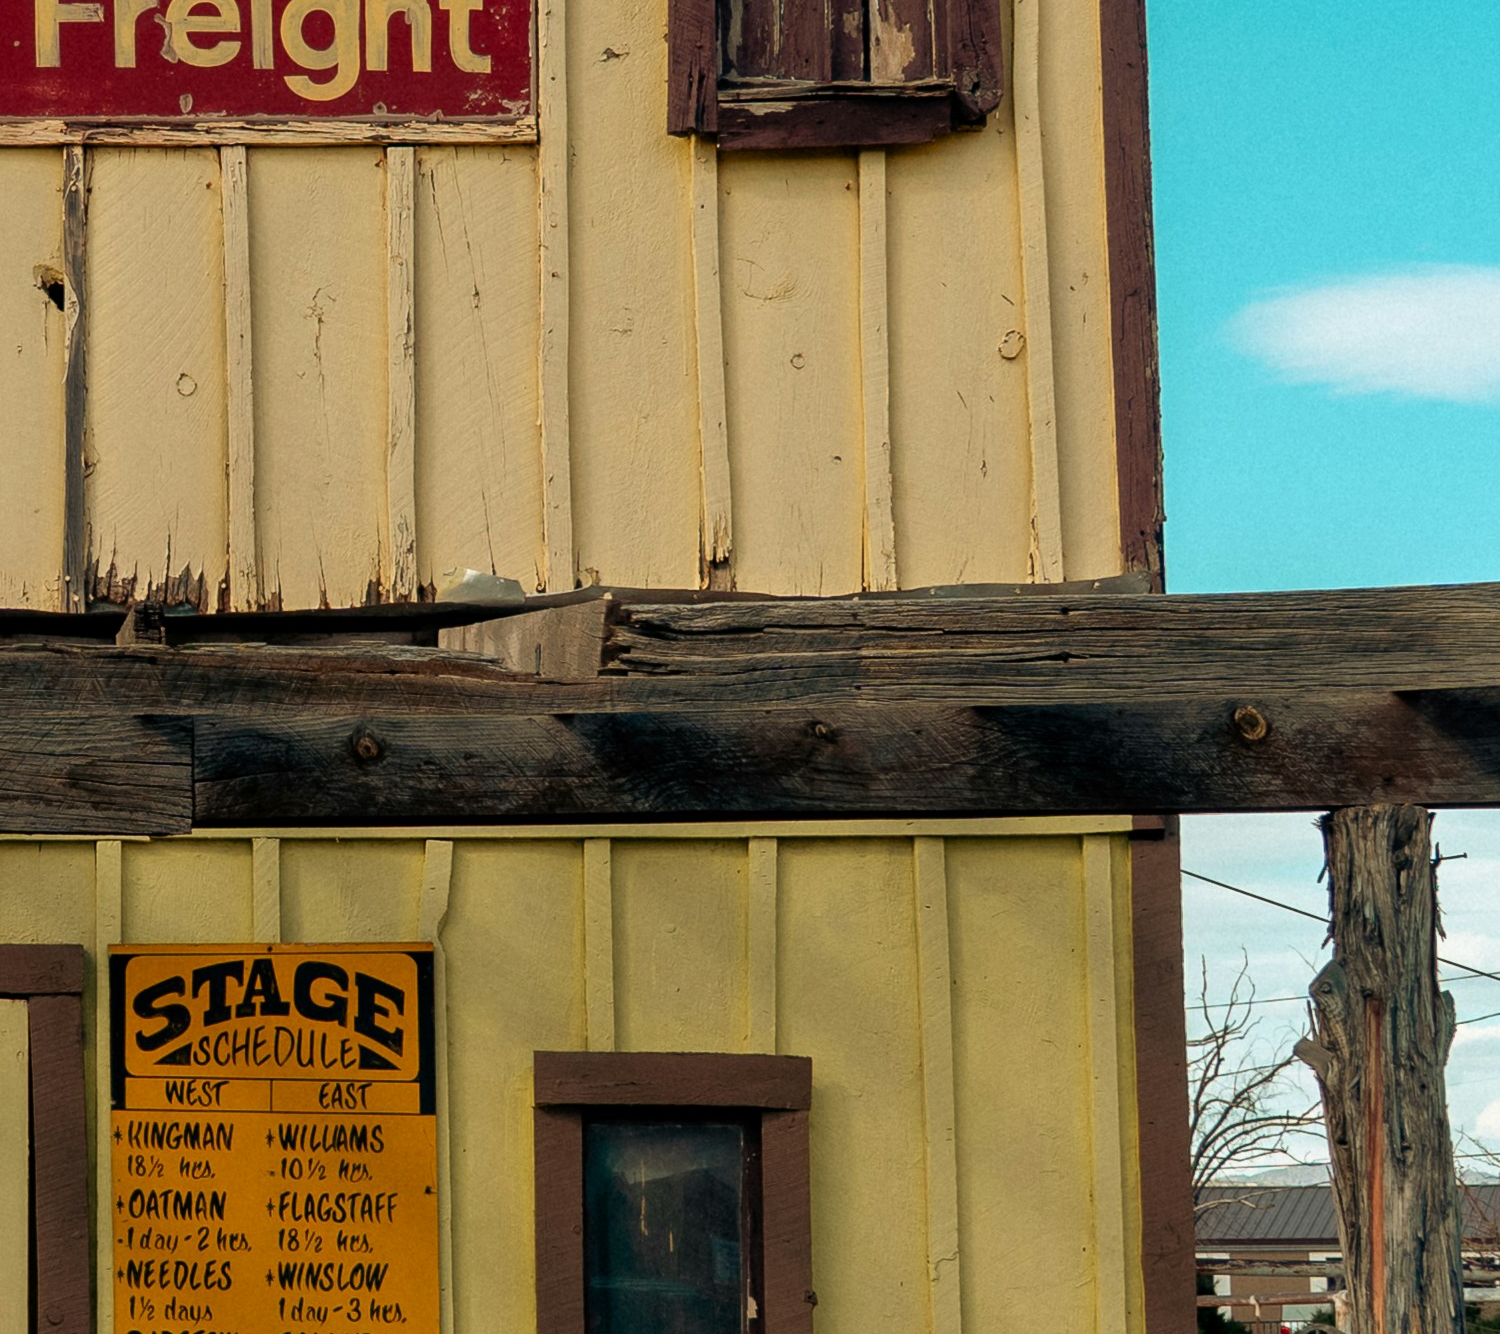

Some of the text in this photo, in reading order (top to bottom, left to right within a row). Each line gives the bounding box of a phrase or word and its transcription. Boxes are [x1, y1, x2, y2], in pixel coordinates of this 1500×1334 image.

[133, 958, 405, 1058] STAGE
[193, 1025, 357, 1069] SCHEDULE
[166, 1079, 230, 1107] WEST
[318, 1082, 373, 1110] EAST
[127, 1120, 234, 1151] KINGMAN
[128, 1188, 227, 1221] OATMAN
[279, 1191, 398, 1224] FLAGSTAFF
[126, 1259, 232, 1291] NEEDLES
[278, 1261, 389, 1292] WINSLOW
[164, 1296, 213, 1326] days
